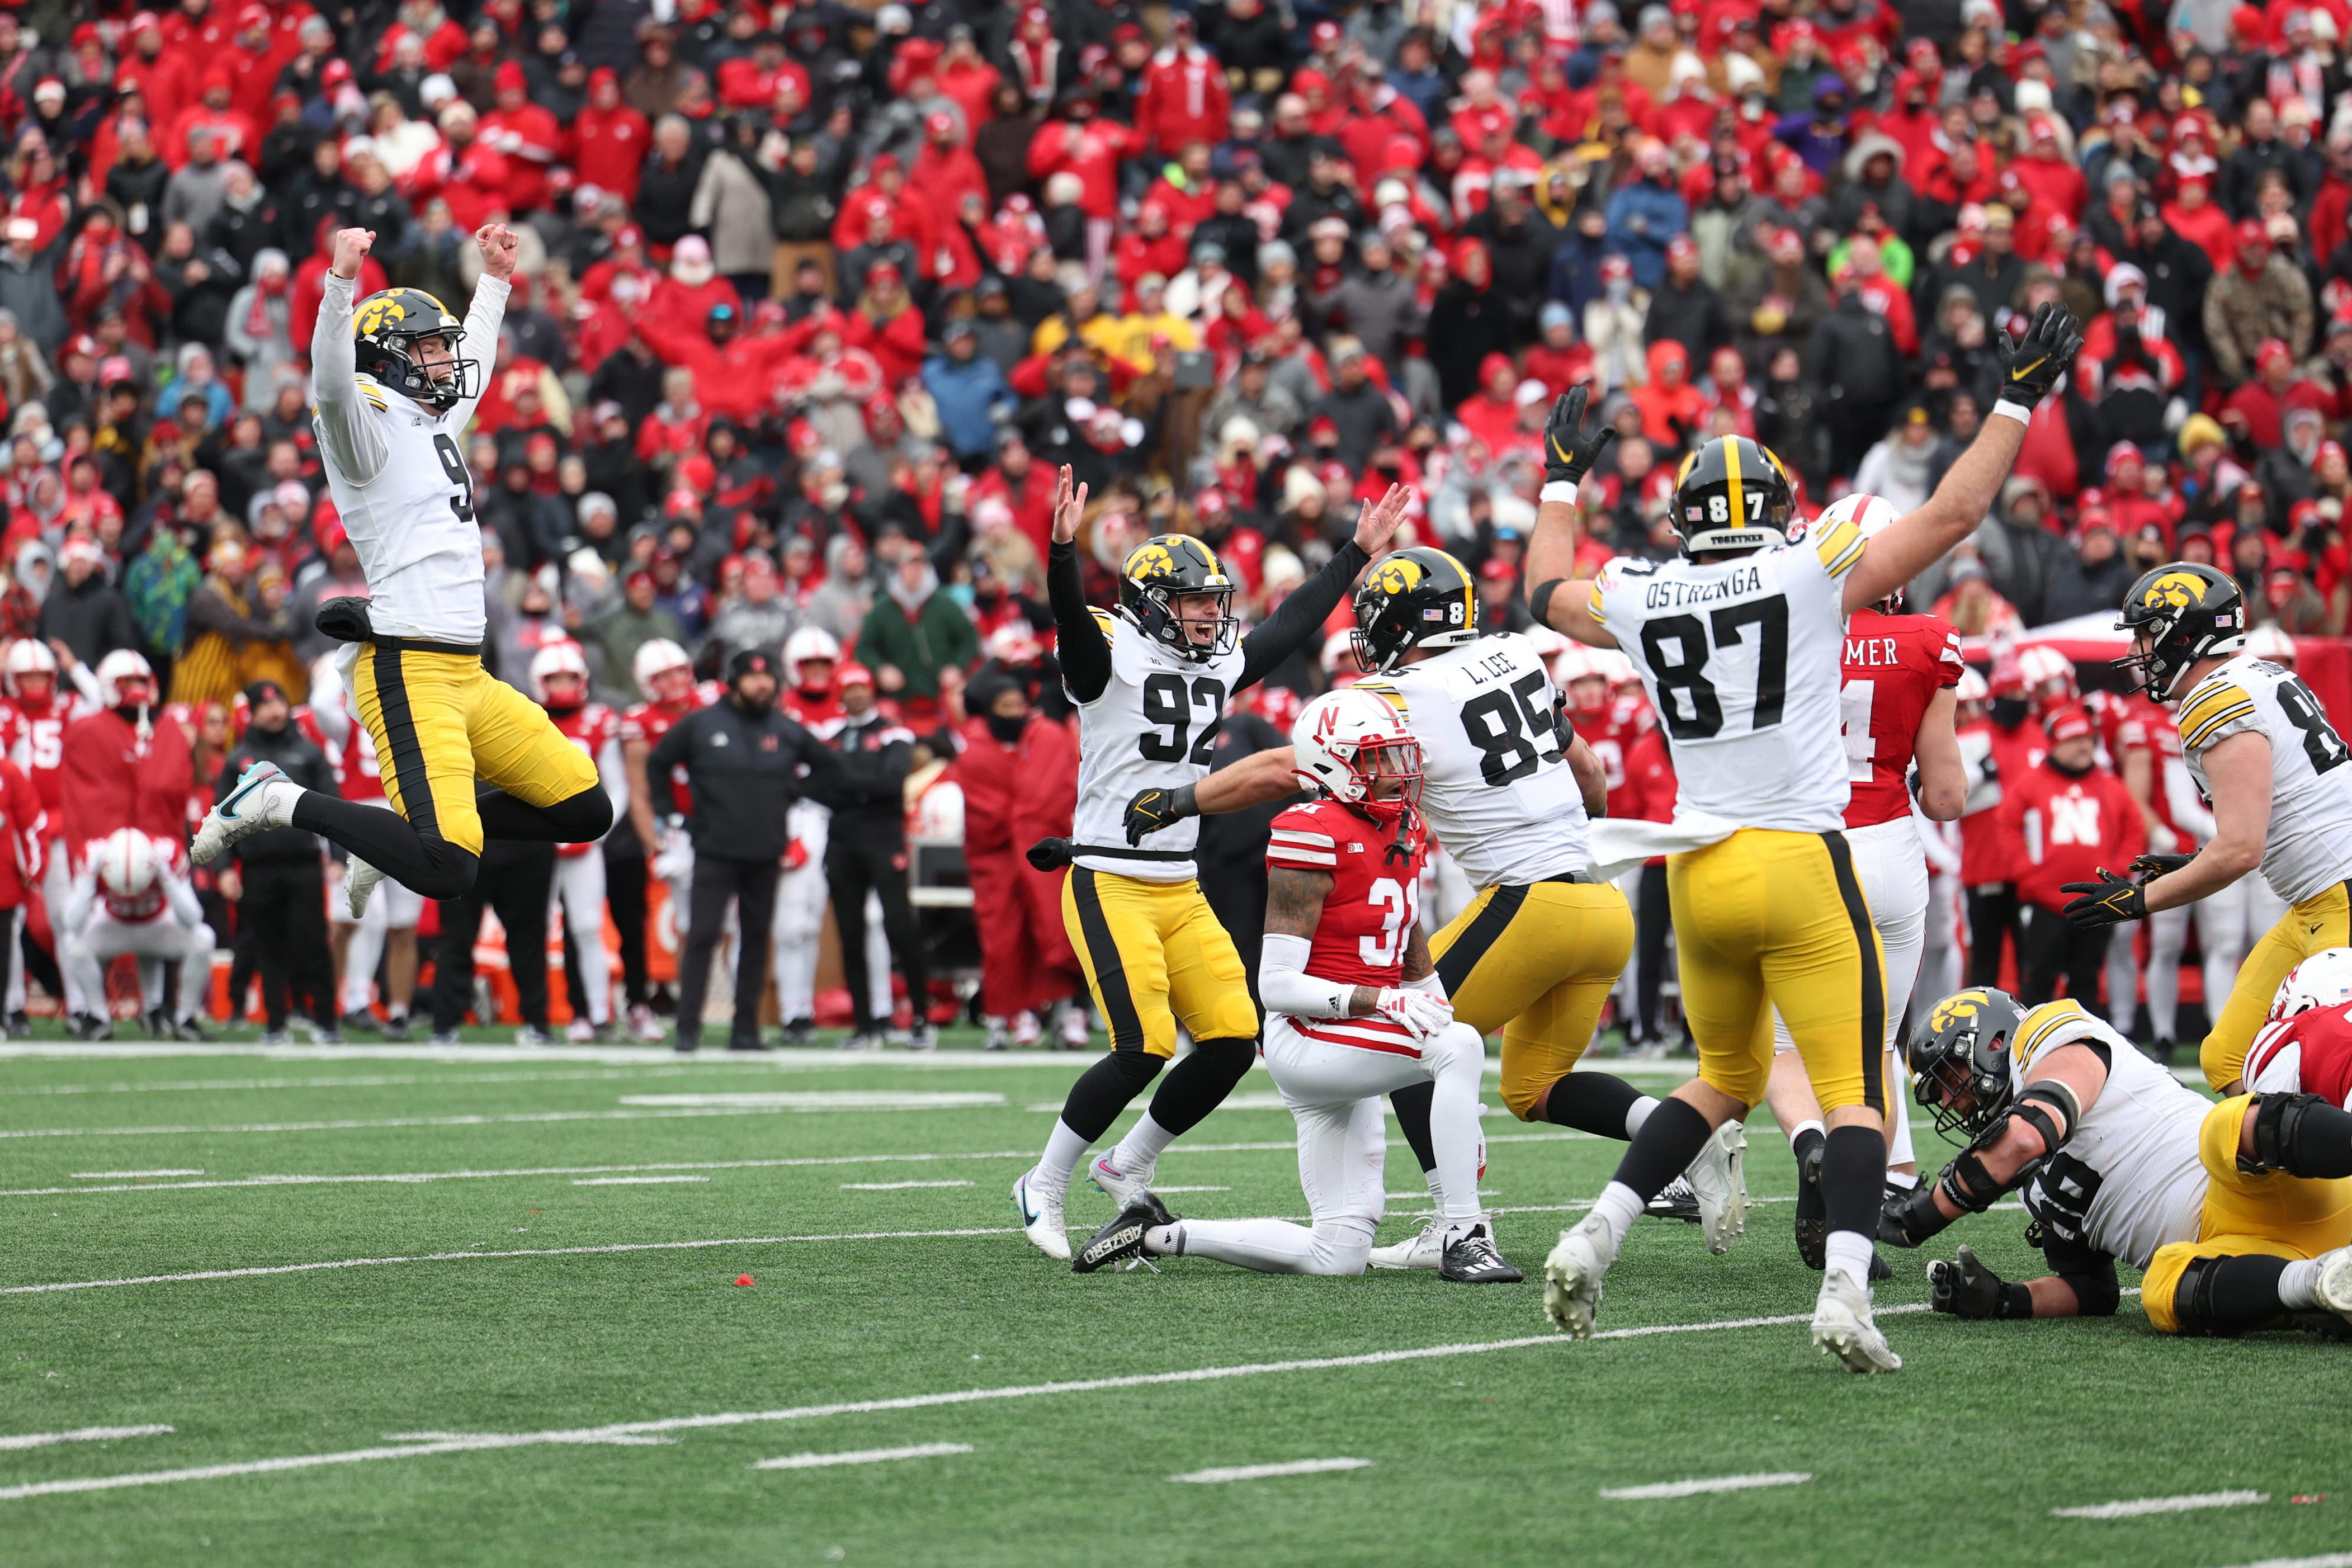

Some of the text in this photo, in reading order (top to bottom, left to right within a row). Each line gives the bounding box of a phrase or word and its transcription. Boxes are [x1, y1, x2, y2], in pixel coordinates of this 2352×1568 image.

[433, 433, 474, 523] 9
[1711, 534, 1764, 545] TOGETHER
[1647, 566, 1761, 610] OSTRENGA
[1461, 652, 1518, 685] L. LEE
[1640, 593, 1789, 740] 87
[1844, 638, 1898, 666] MER
[1139, 673, 1226, 766] 92
[1317, 707, 1340, 736] N
[1460, 668, 1564, 787] 85
[2051, 797, 2101, 847] N
[1358, 877, 1420, 967] 31
[1943, 1180, 1972, 1208] DONJOY
